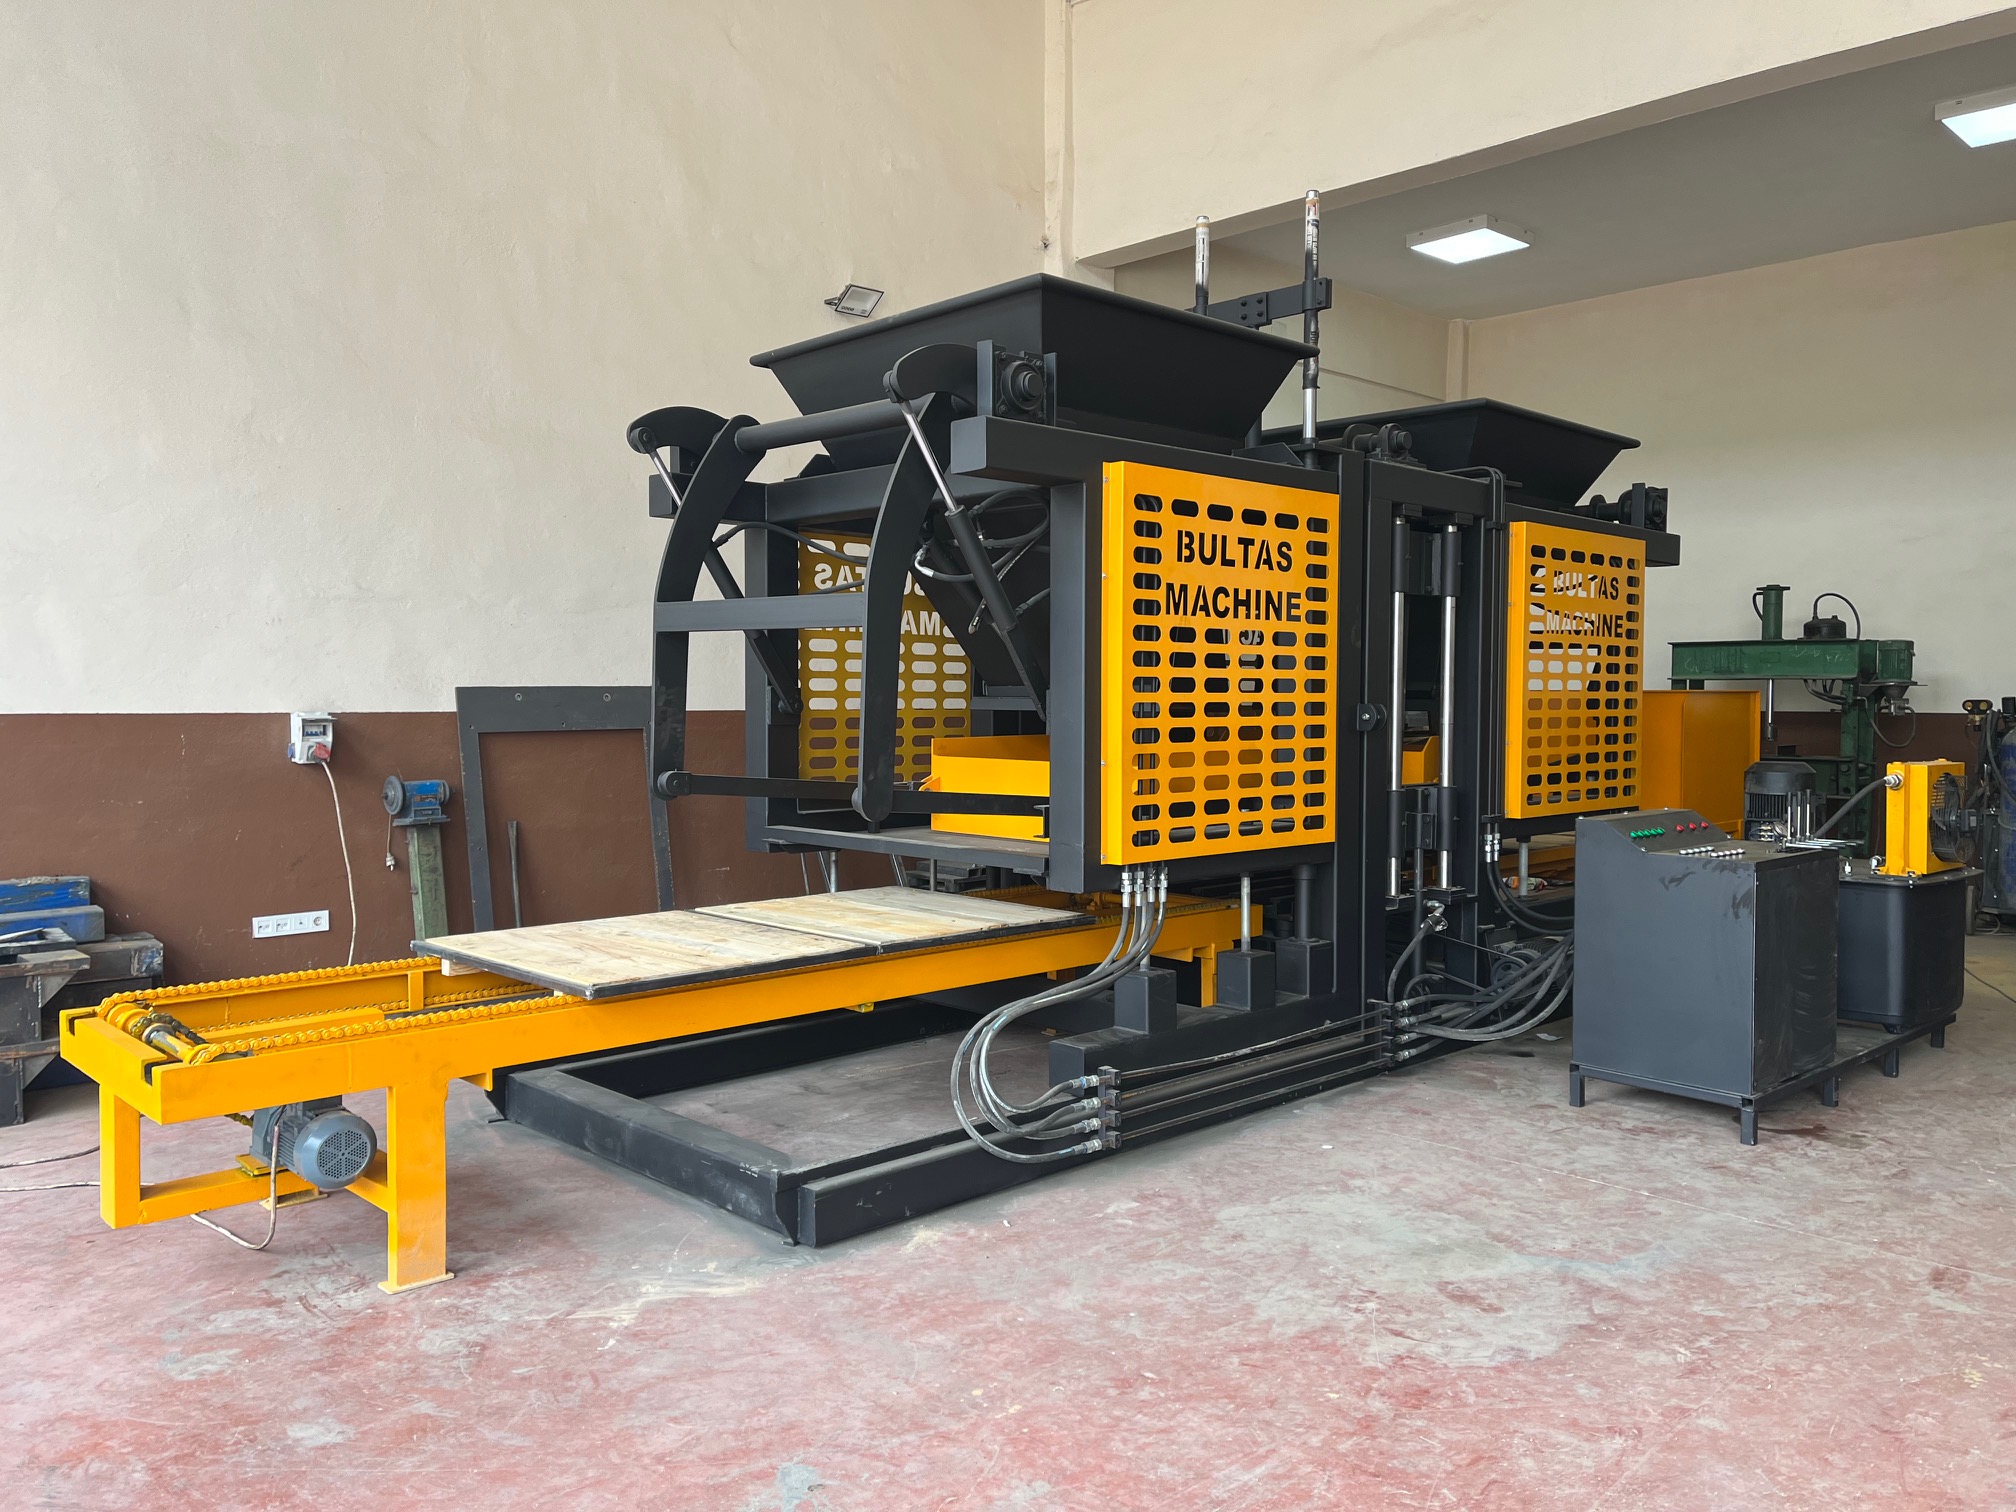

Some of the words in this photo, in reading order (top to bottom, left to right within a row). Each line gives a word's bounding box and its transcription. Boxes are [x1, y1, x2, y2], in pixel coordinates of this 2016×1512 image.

[1176, 529, 1292, 572] BULTAS
[1165, 582, 1302, 622] MACHINE
[1553, 570, 1619, 600] BULTAS
[1546, 609, 1624, 638] MACHINE
